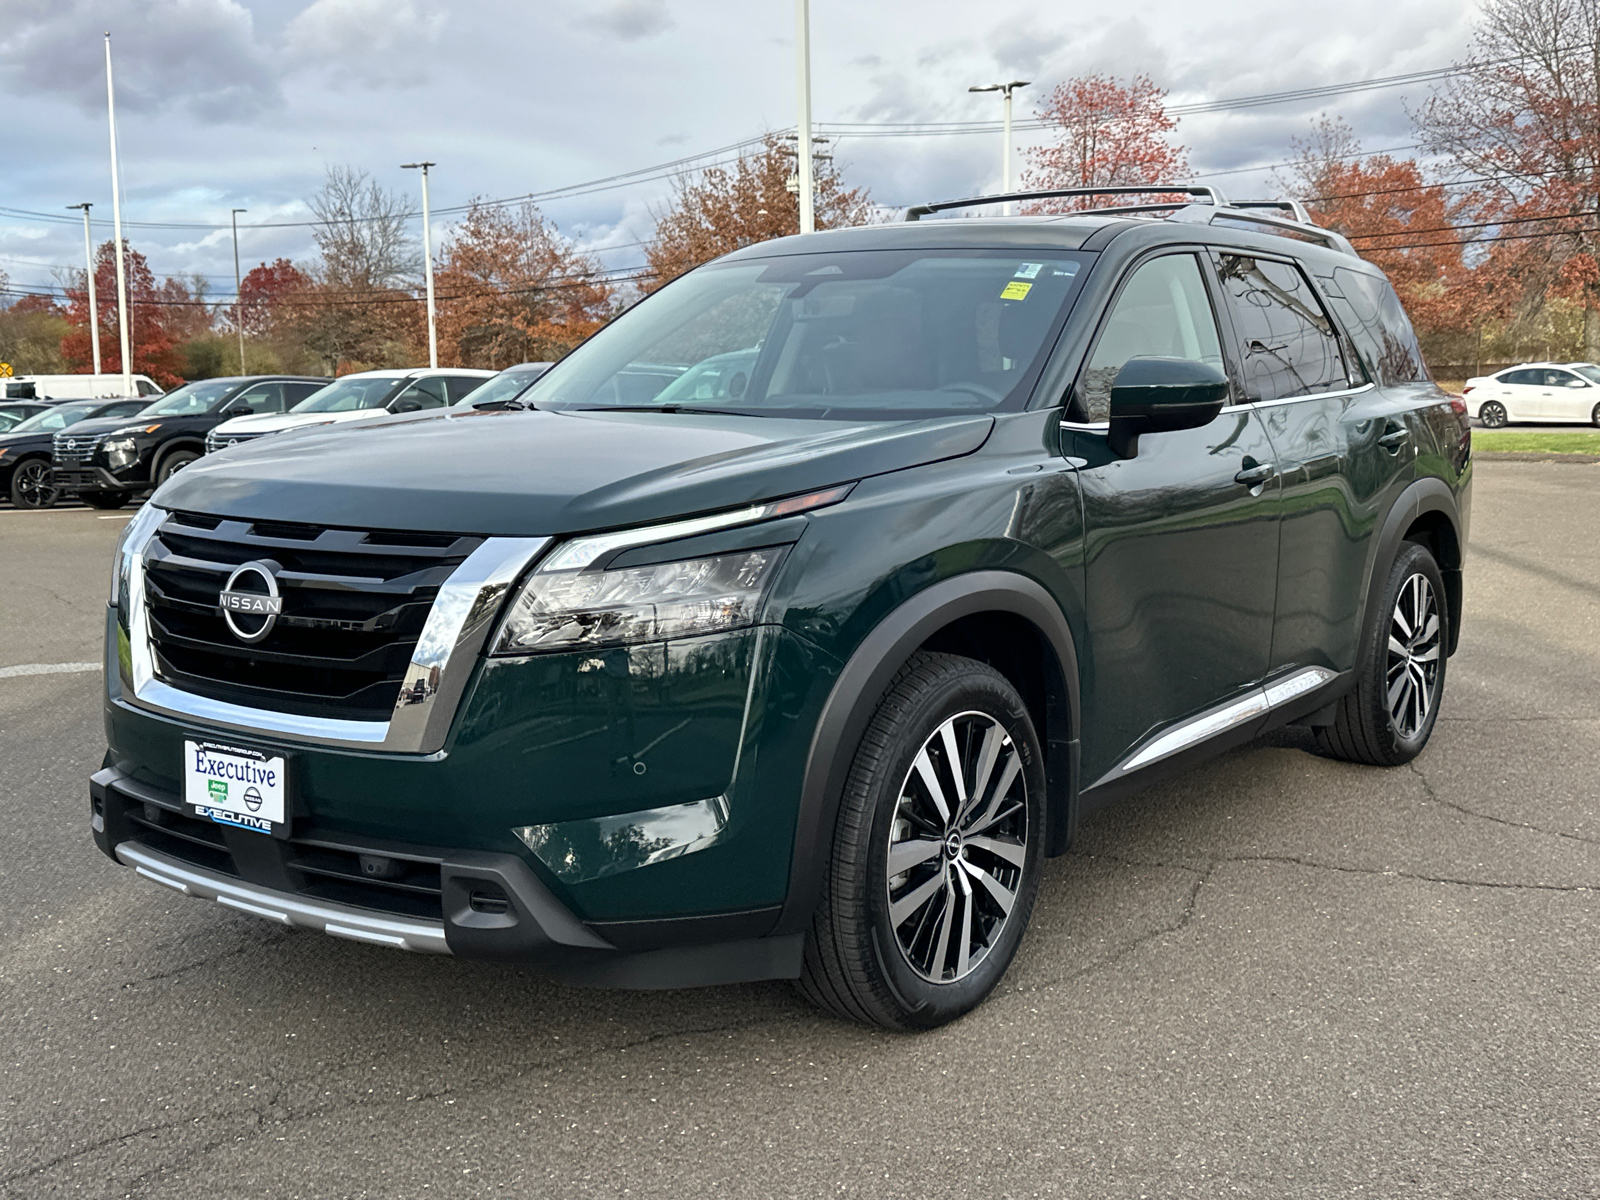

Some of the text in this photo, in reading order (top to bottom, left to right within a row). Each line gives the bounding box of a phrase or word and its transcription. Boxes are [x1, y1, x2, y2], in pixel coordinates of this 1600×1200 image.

[219, 594, 279, 612] NISSAN
[195, 749, 276, 788] Executive
[211, 783, 226, 792] Jeep
[195, 805, 272, 831] EXECUTIVE
